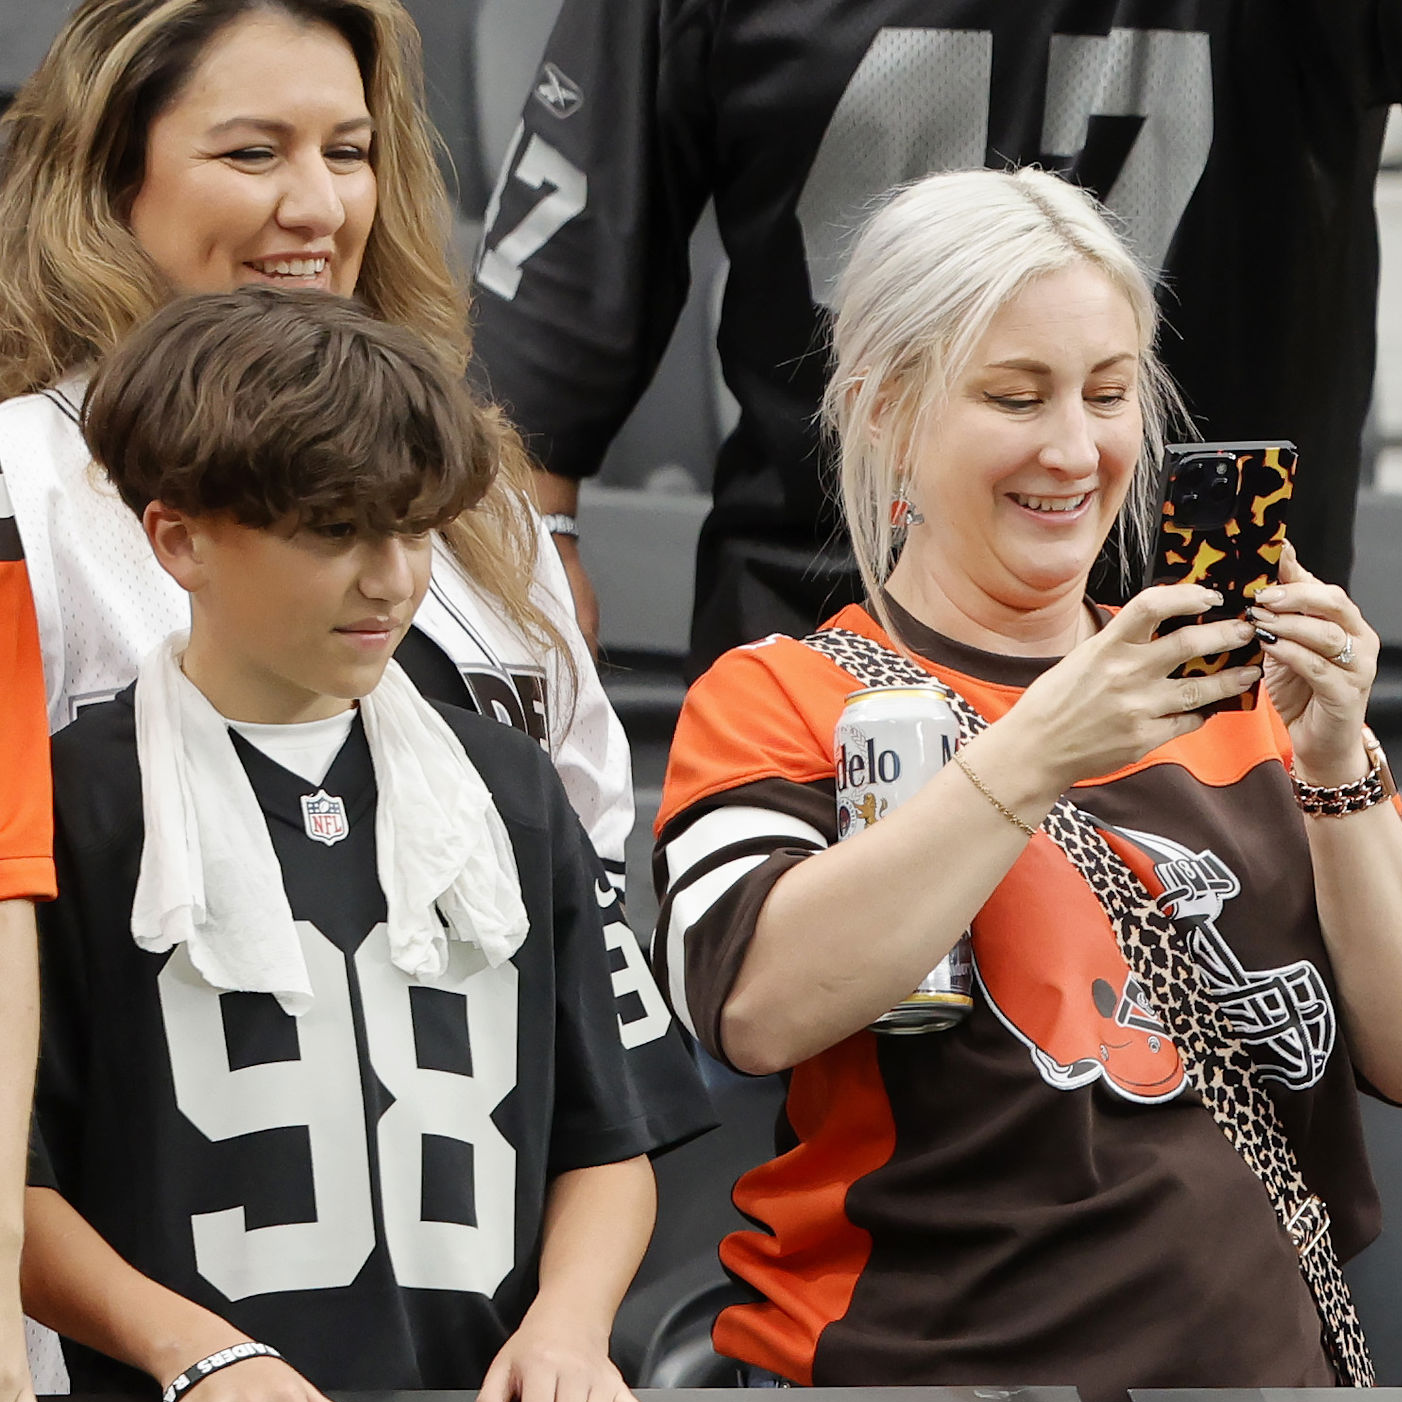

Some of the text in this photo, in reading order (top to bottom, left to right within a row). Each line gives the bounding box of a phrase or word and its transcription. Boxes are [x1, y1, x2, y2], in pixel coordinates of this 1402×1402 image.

[474, 131, 588, 302] 7
[312, 815, 342, 836] NFL
[157, 920, 520, 1302] 98
